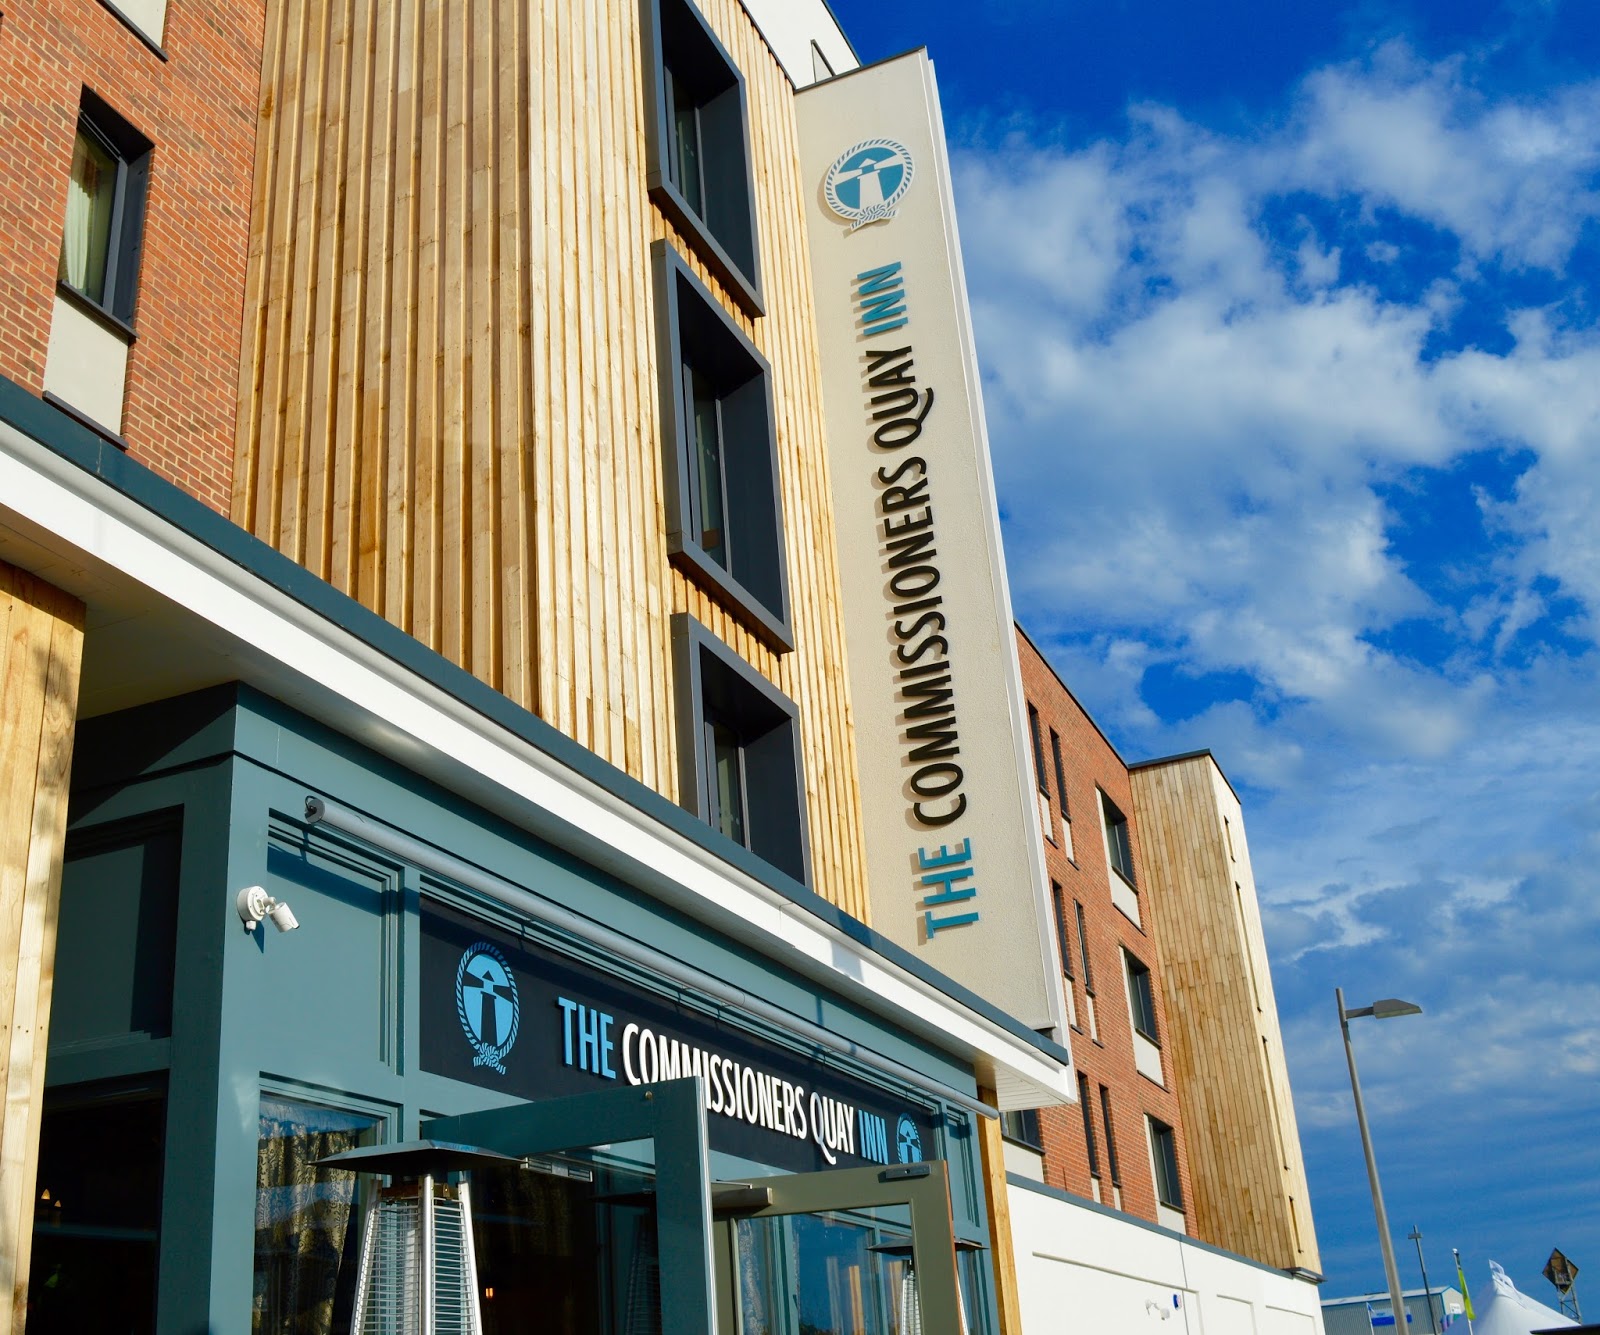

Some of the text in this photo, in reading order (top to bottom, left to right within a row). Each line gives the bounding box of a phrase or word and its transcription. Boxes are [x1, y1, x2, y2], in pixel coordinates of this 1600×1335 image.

[857, 261, 980, 940] THE COMMISSIONERS QUAY INN
[558, 996, 616, 1079] THE
[809, 1091, 854, 1165] QUAY
[858, 1110, 888, 1164] INN
